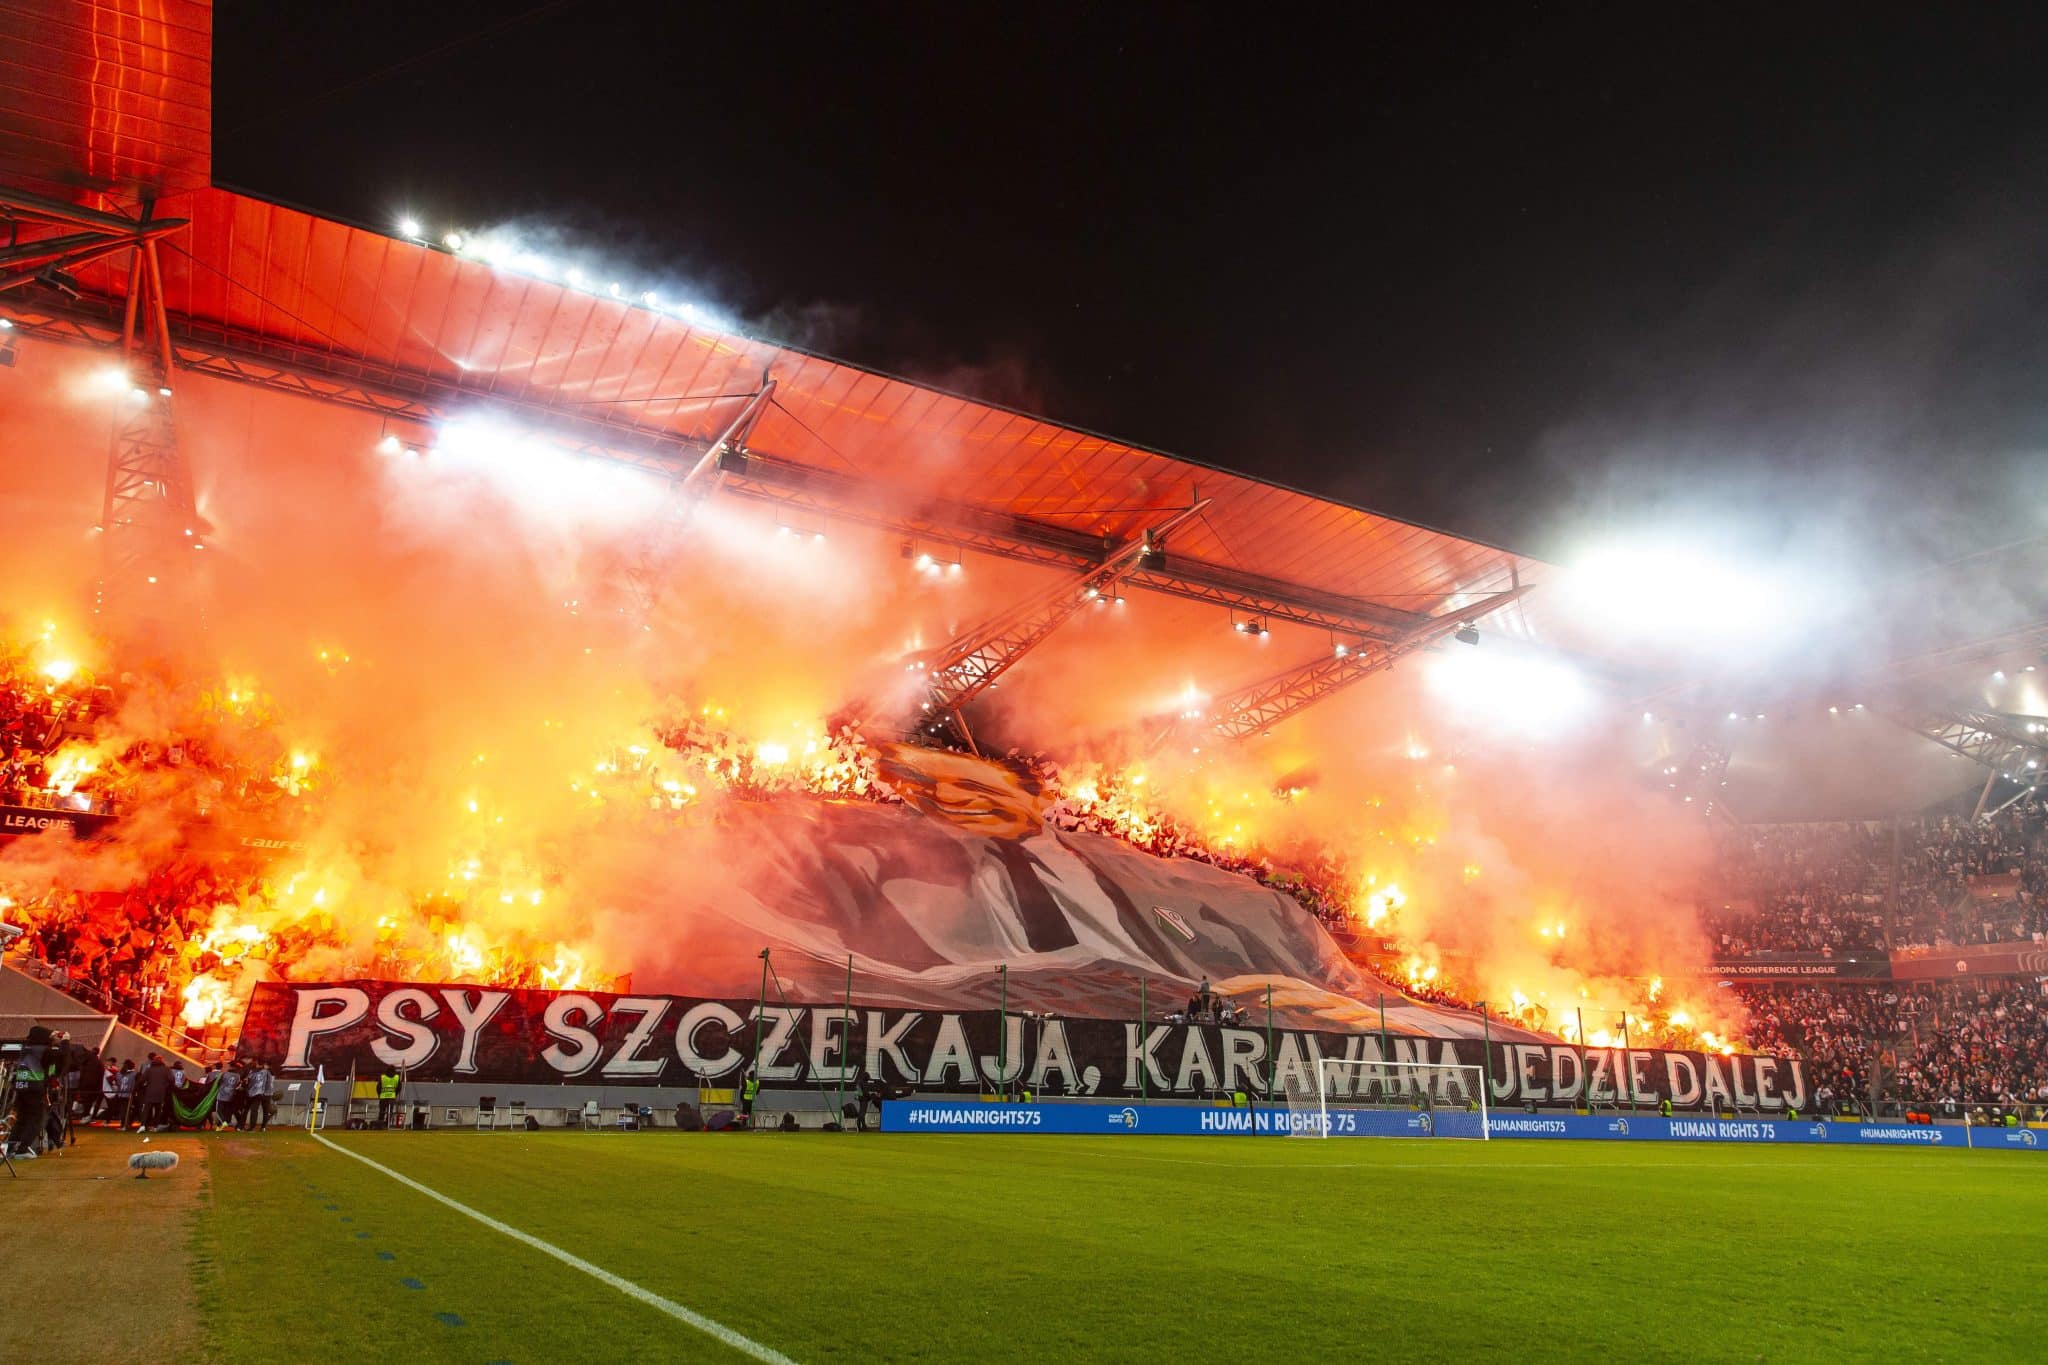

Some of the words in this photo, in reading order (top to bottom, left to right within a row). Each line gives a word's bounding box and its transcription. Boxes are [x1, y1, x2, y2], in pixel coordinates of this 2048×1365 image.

[4, 814, 71, 831] LEAGUE
[1703, 966, 1737, 975] EUROPA
[1738, 966, 1799, 975] CONFERENCE
[1800, 966, 1837, 975] LEAGUE
[280, 987, 511, 1074] PSY
[1122, 1023, 1476, 1100] KARAWANA
[1488, 1044, 1659, 1104] JEDZIE
[1664, 1053, 1806, 1110] DALEJ
[909, 1109, 1041, 1125] #HUMANRIGHTS75
[1201, 1111, 1270, 1131] HUMAN
[1274, 1112, 1333, 1131] RIGHTS
[1337, 1114, 1356, 1131] 75
[1669, 1121, 1717, 1137] HUMAN
[1719, 1123, 1759, 1138] RIGHTS
[1761, 1124, 1775, 1138] 75
[1860, 1128, 1943, 1141] #HUMANRIGHTS75
